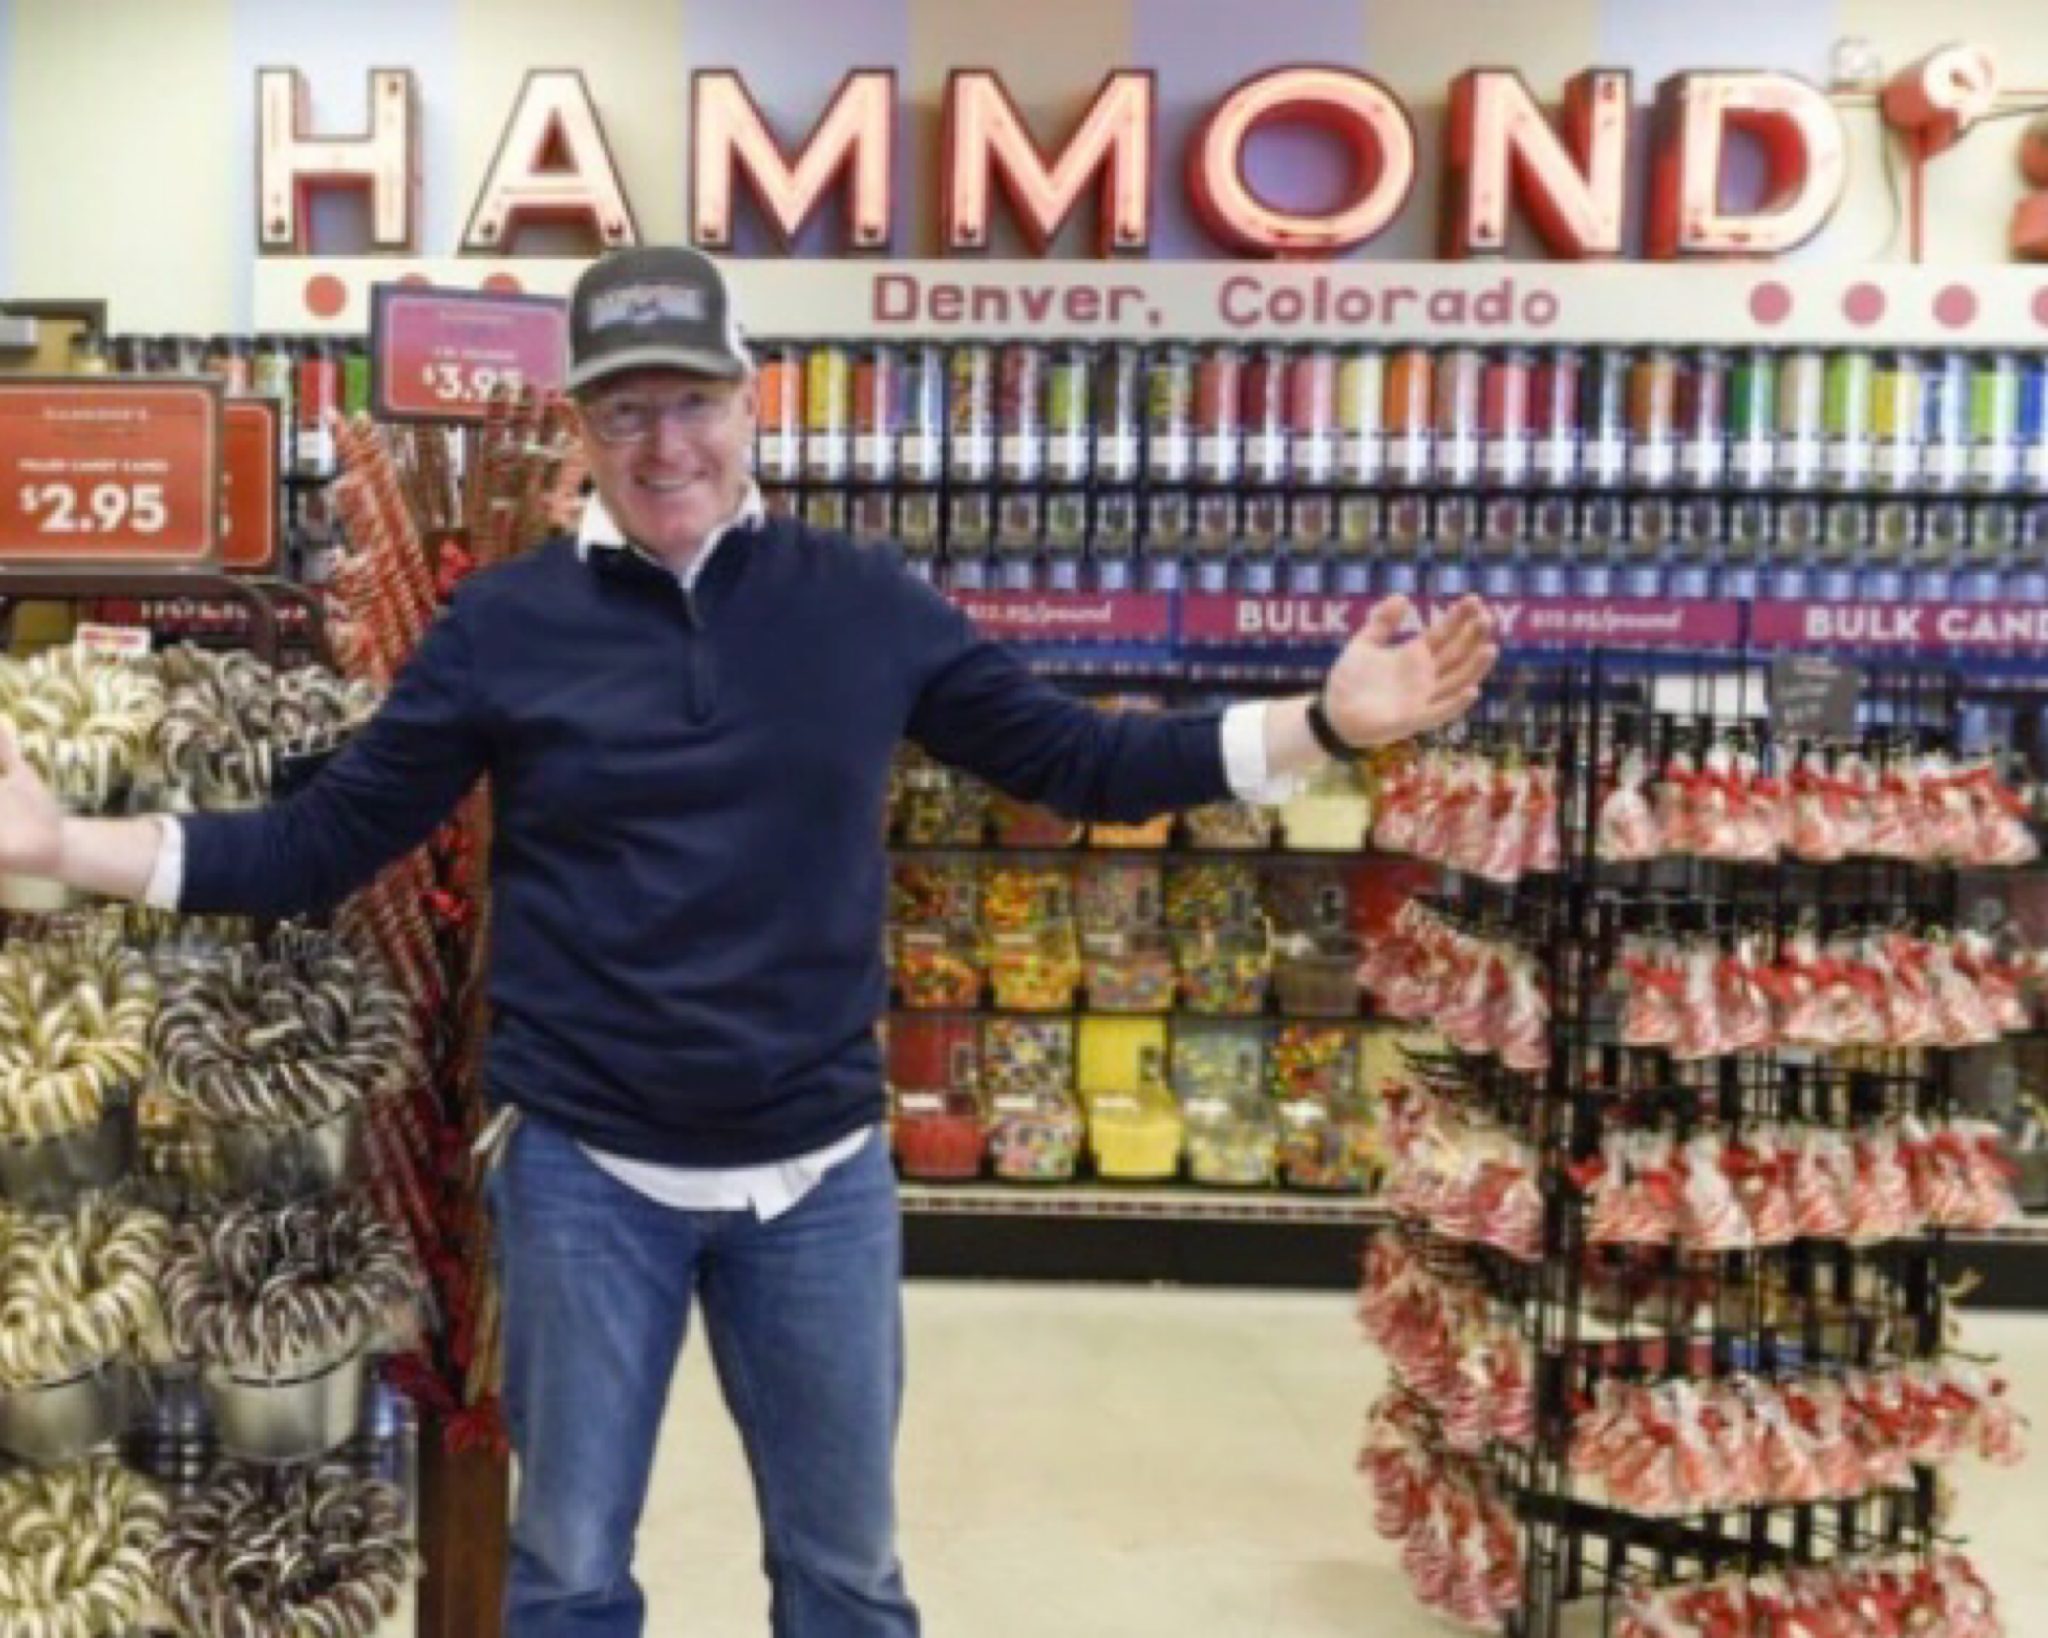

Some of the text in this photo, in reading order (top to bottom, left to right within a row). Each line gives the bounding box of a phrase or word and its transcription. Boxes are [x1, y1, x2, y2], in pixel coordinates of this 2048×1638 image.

[254, 64, 2048, 258] HAMMOND'
[870, 273, 1561, 329] Denver, Colorado
[19, 483, 168, 533] $2.95
[1236, 599, 1349, 633] BULK
[1805, 605, 1923, 641] BULK
